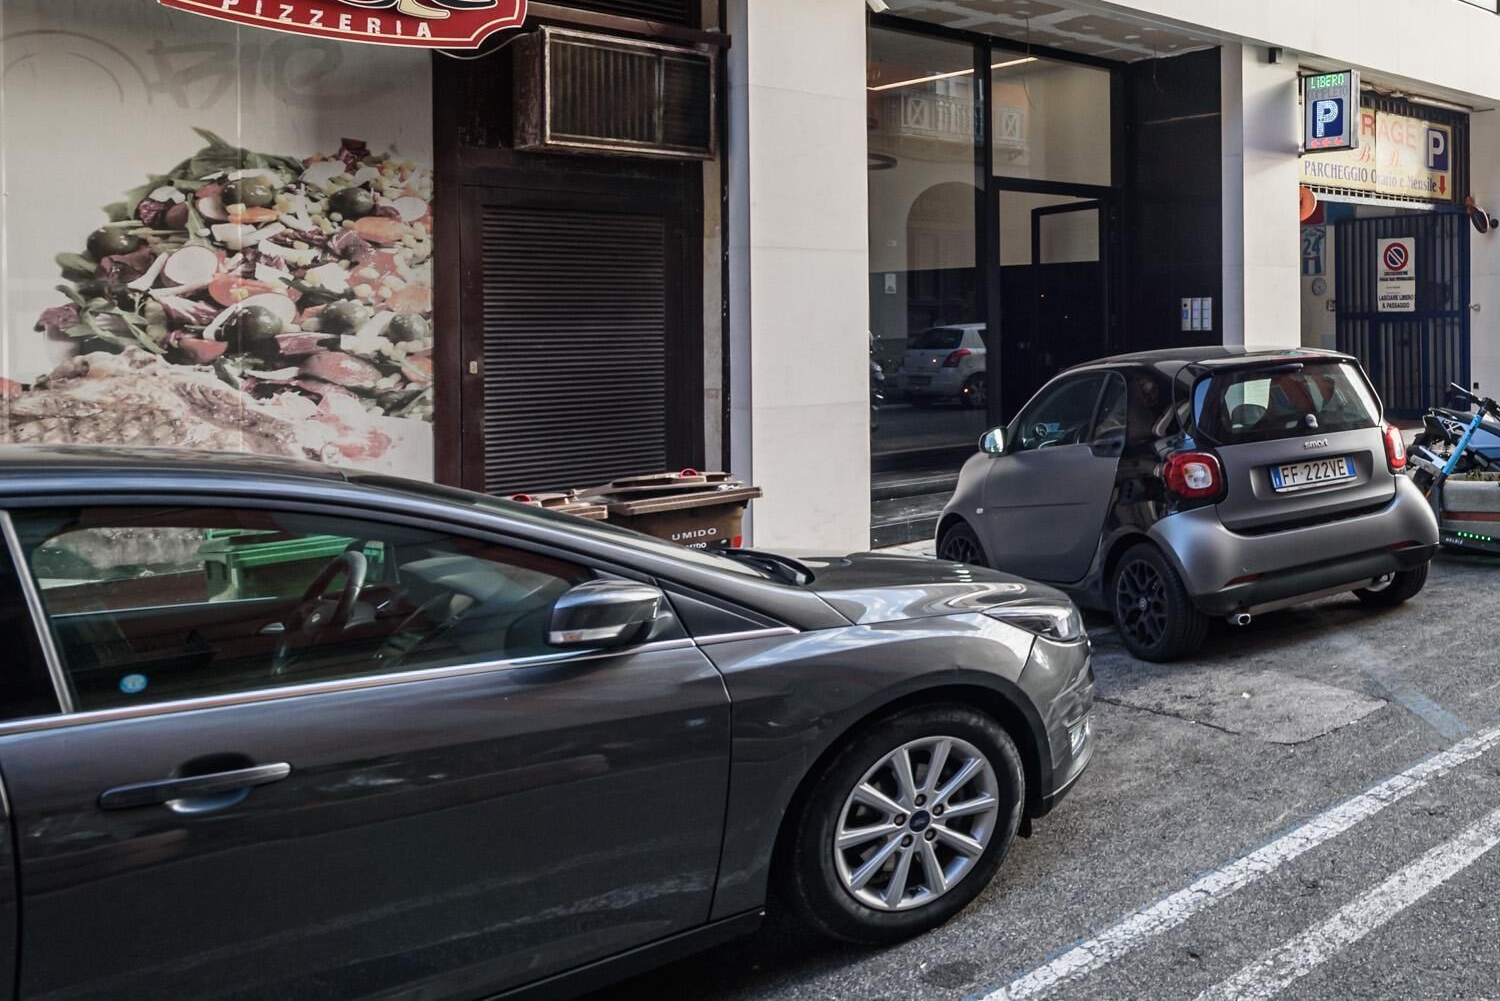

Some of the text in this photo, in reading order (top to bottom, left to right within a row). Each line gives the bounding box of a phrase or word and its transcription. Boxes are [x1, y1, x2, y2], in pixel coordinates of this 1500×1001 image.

[1361, 113, 1416, 151] RAGE
[1304, 159, 1368, 183] PARCHEGGIO
[1370, 167, 1398, 188] Orario
[673, 528, 716, 540] UMIDO
